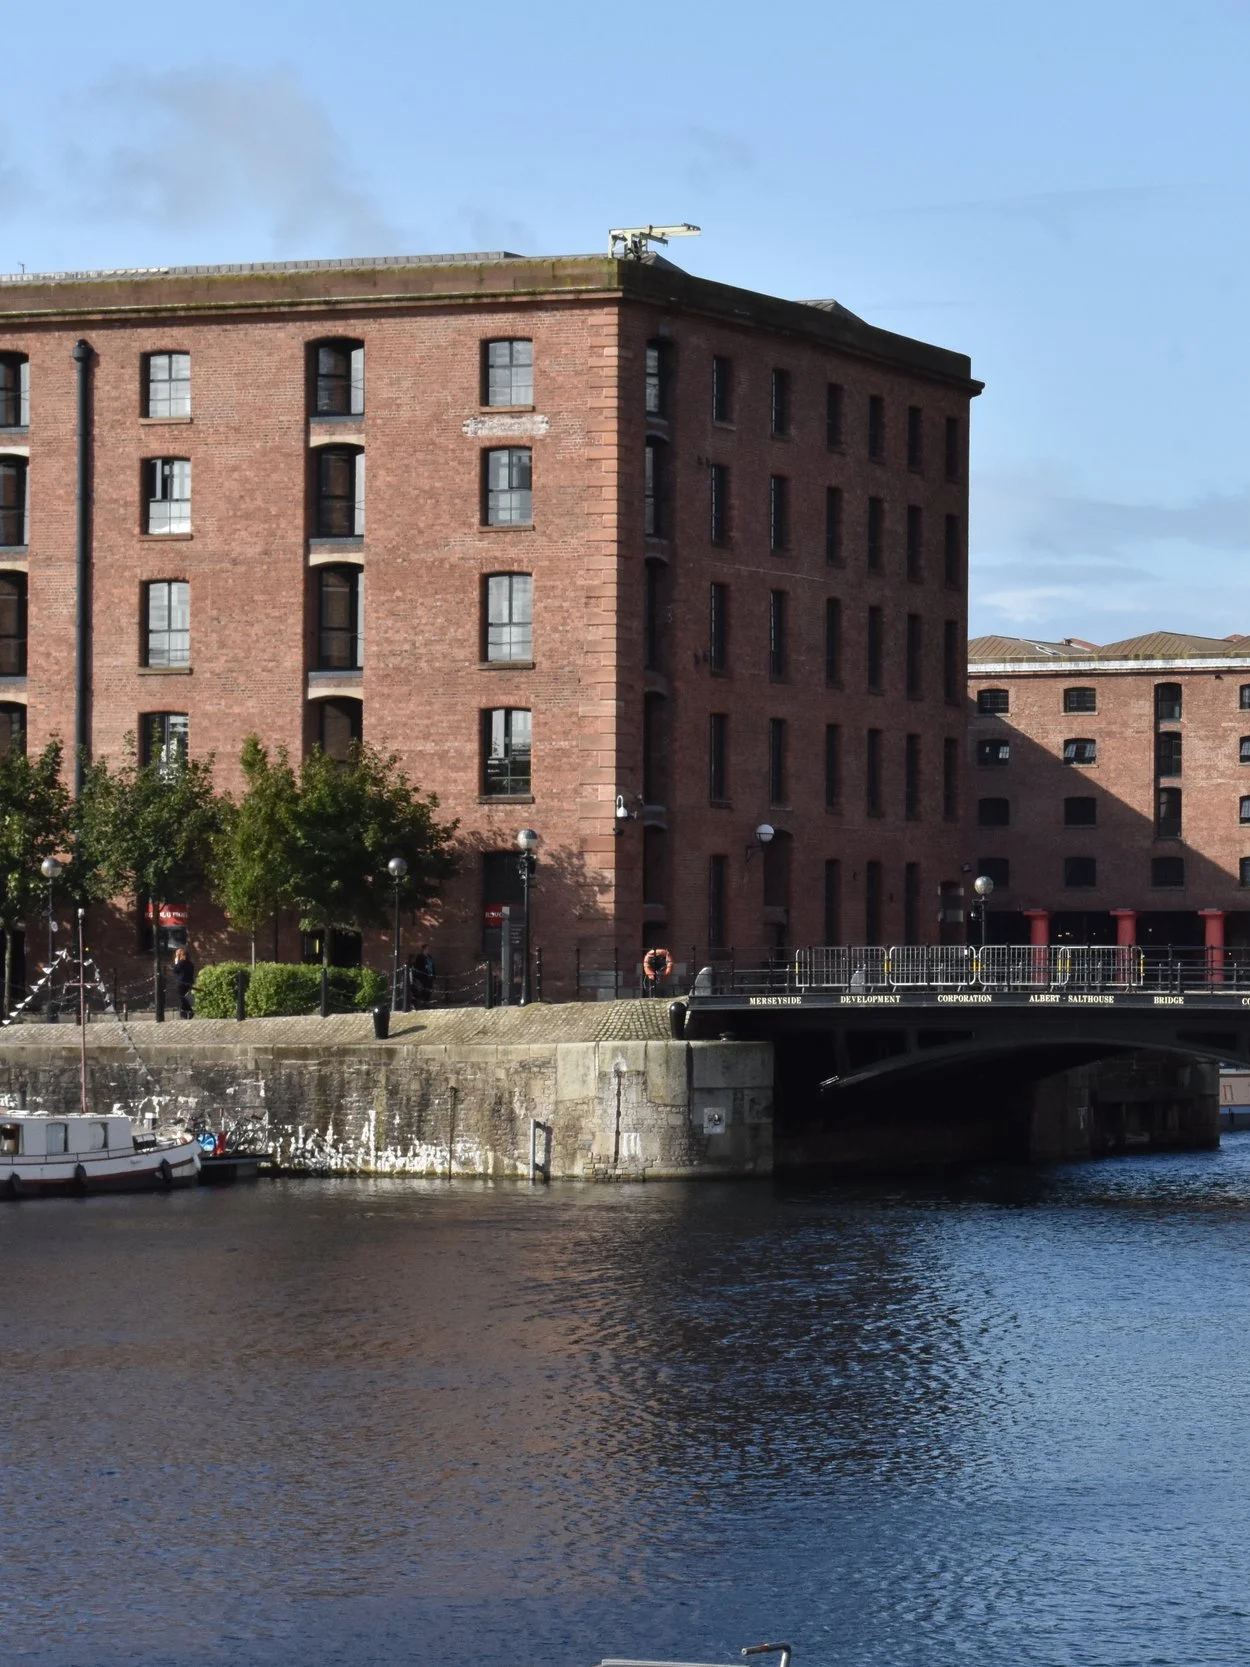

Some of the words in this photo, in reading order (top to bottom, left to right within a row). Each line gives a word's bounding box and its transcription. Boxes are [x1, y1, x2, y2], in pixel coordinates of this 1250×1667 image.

[749, 996, 802, 1005] MERSEYSIDE
[840, 995, 901, 1004] DEVELOPMENT
[937, 994, 992, 1003] CORPORATION
[1029, 994, 1061, 1003] ALBERT
[1068, 995, 1115, 1004] SALTHOUSE
[1153, 996, 1184, 1005] BRIDGE
